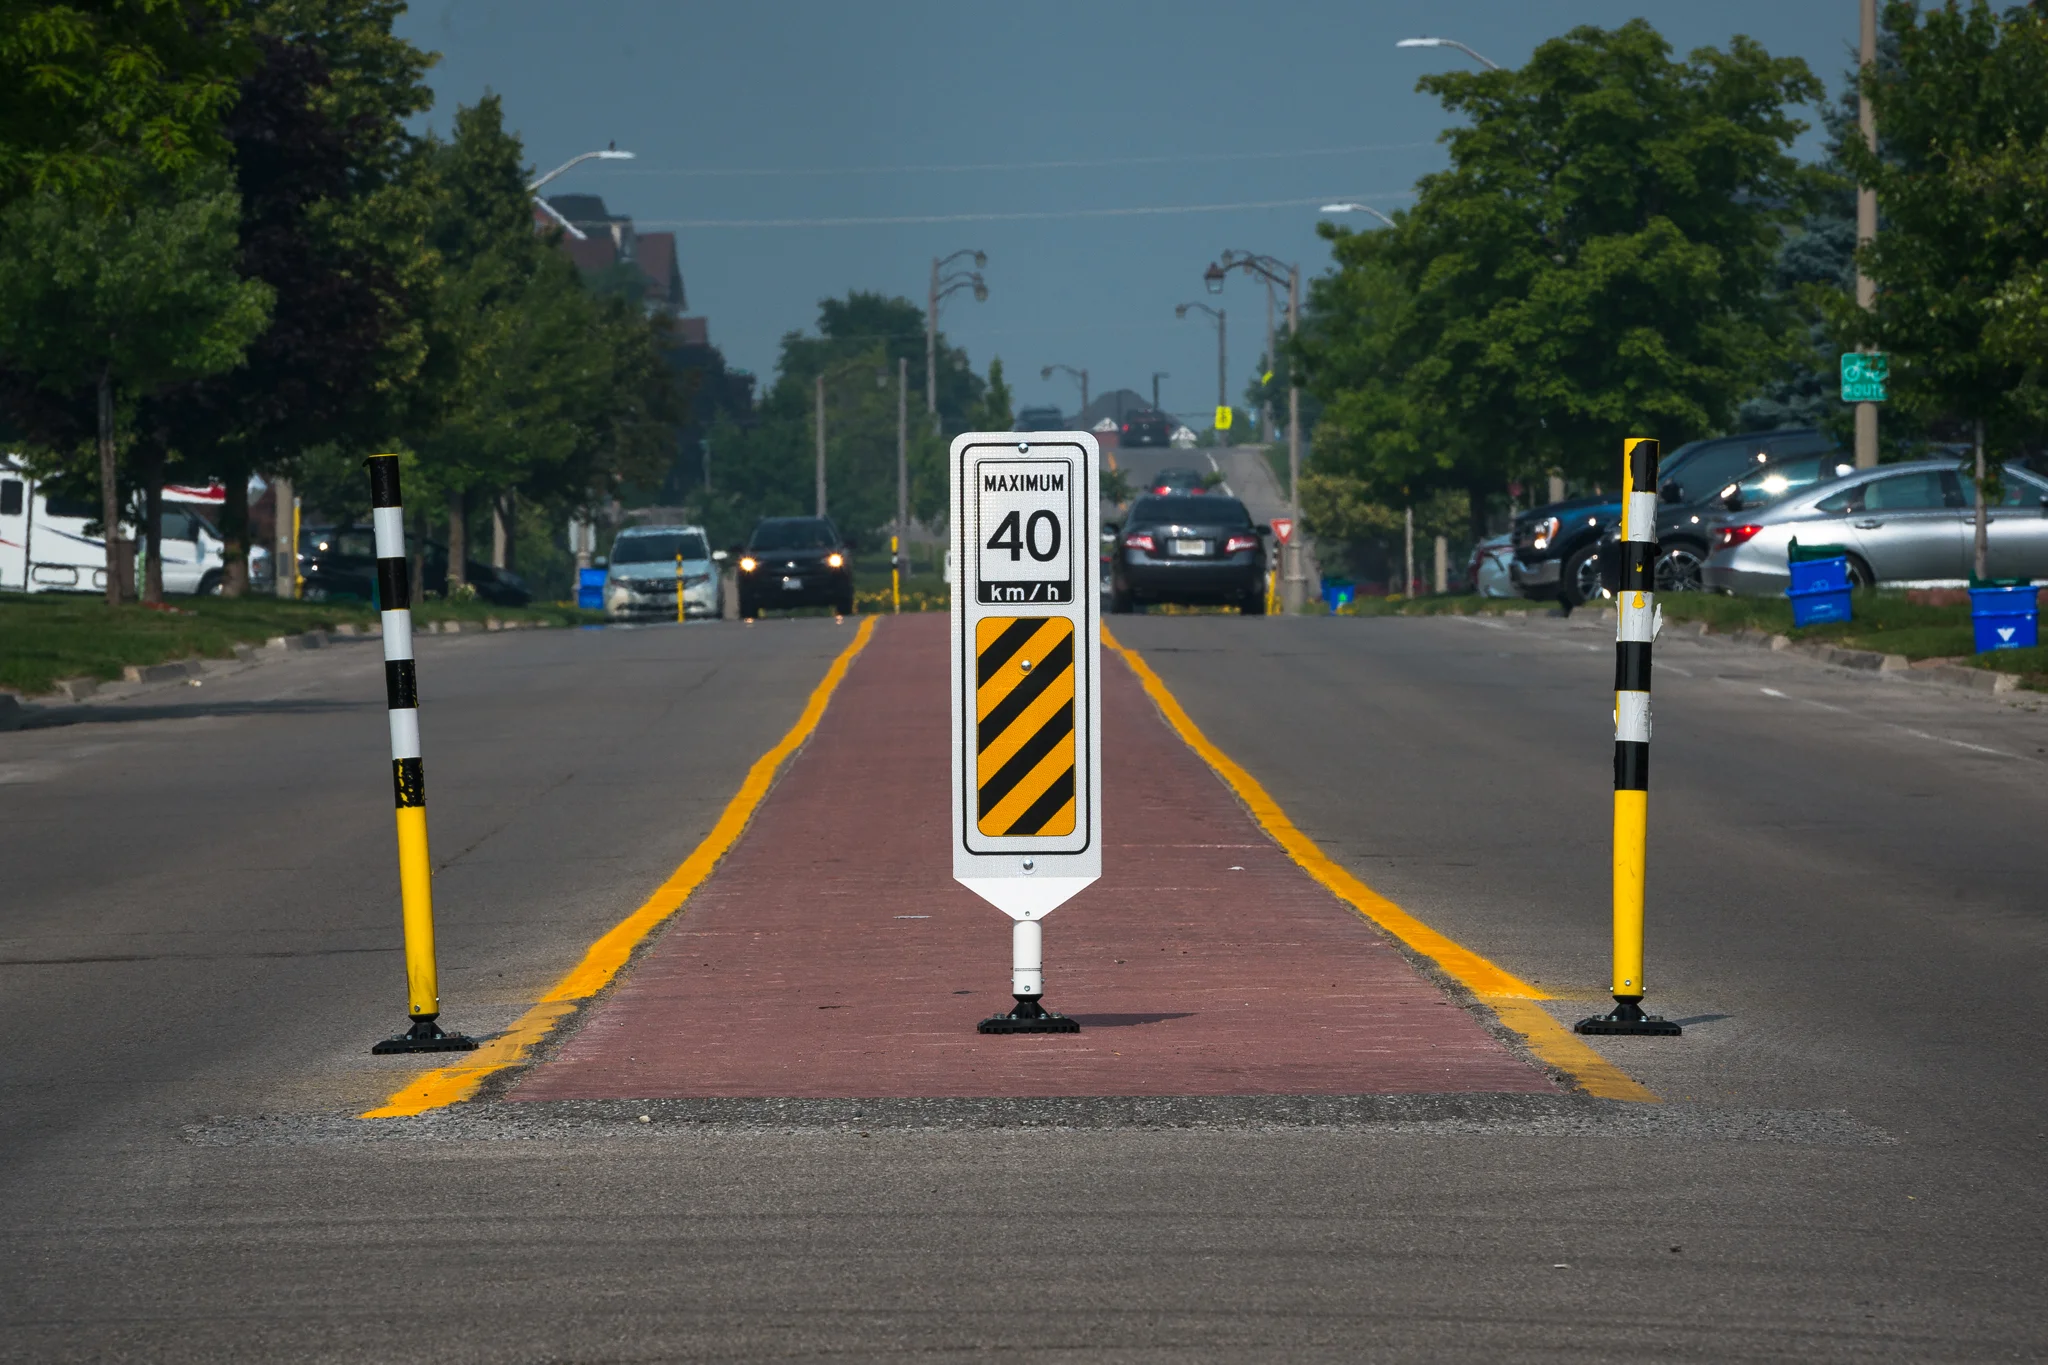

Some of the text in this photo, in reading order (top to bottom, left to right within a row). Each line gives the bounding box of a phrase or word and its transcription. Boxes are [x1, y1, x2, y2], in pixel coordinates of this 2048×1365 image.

[985, 474, 1064, 492] MAXIMUM
[986, 509, 1062, 562] 40
[991, 583, 1060, 601] km/h
